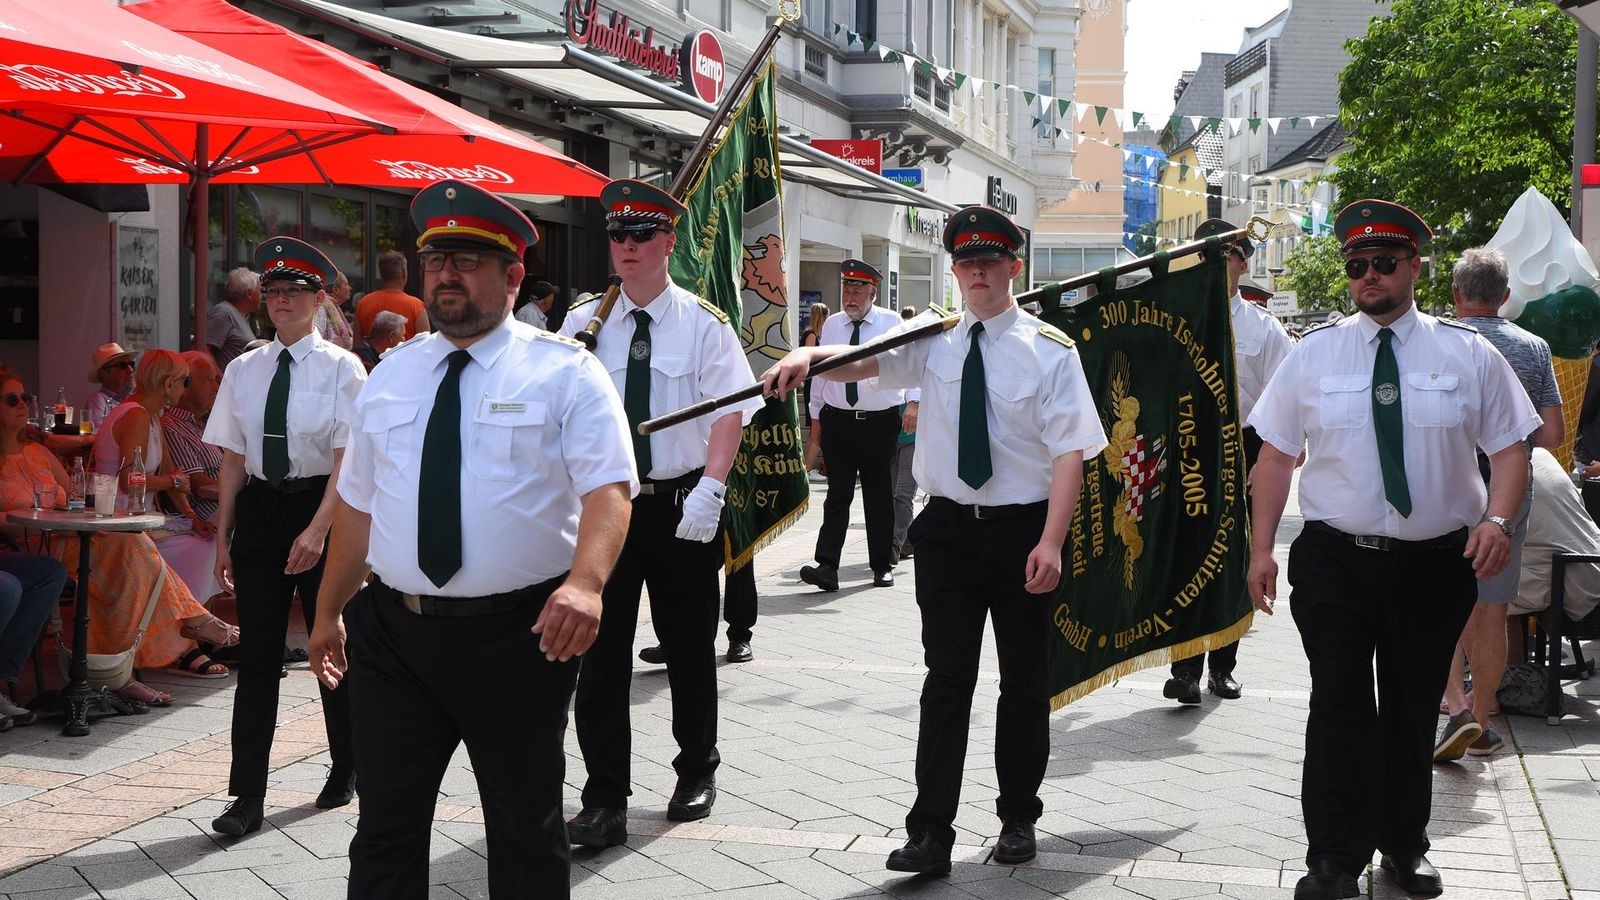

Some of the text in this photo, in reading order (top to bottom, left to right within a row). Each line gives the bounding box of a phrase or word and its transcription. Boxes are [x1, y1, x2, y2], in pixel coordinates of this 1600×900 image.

[695, 46, 723, 91] kamp
[120, 265, 155, 289] KAISER
[120, 295, 157, 318] GARTEN
[1099, 300, 1127, 329] 300
[1132, 300, 1173, 332] Jahre
[1174, 316, 1229, 416] Iserlohner
[1177, 391, 1209, 518] 1705-2005
[1087, 458, 1104, 559] rgertreue
[1053, 602, 1093, 653] GmbH
[1113, 612, 1173, 650] Verein
